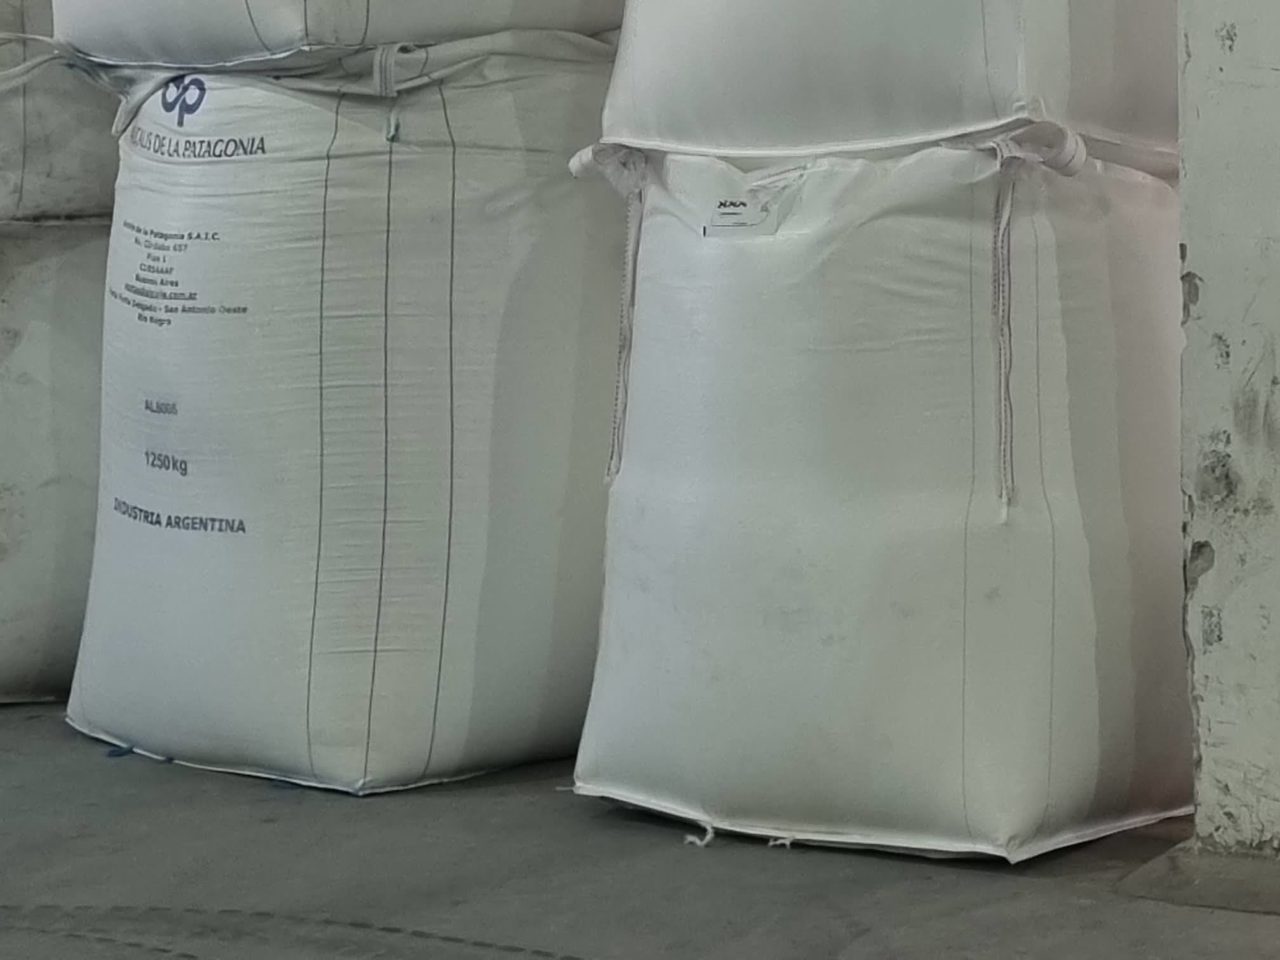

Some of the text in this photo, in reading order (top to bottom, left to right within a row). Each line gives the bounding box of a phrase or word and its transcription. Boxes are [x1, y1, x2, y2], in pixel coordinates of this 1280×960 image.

[153, 134, 165, 156] DE
[167, 137, 180, 158] LA
[182, 136, 266, 159] PATAGONIA
[113, 497, 246, 534] INDUSTRIA ARGENTINA
